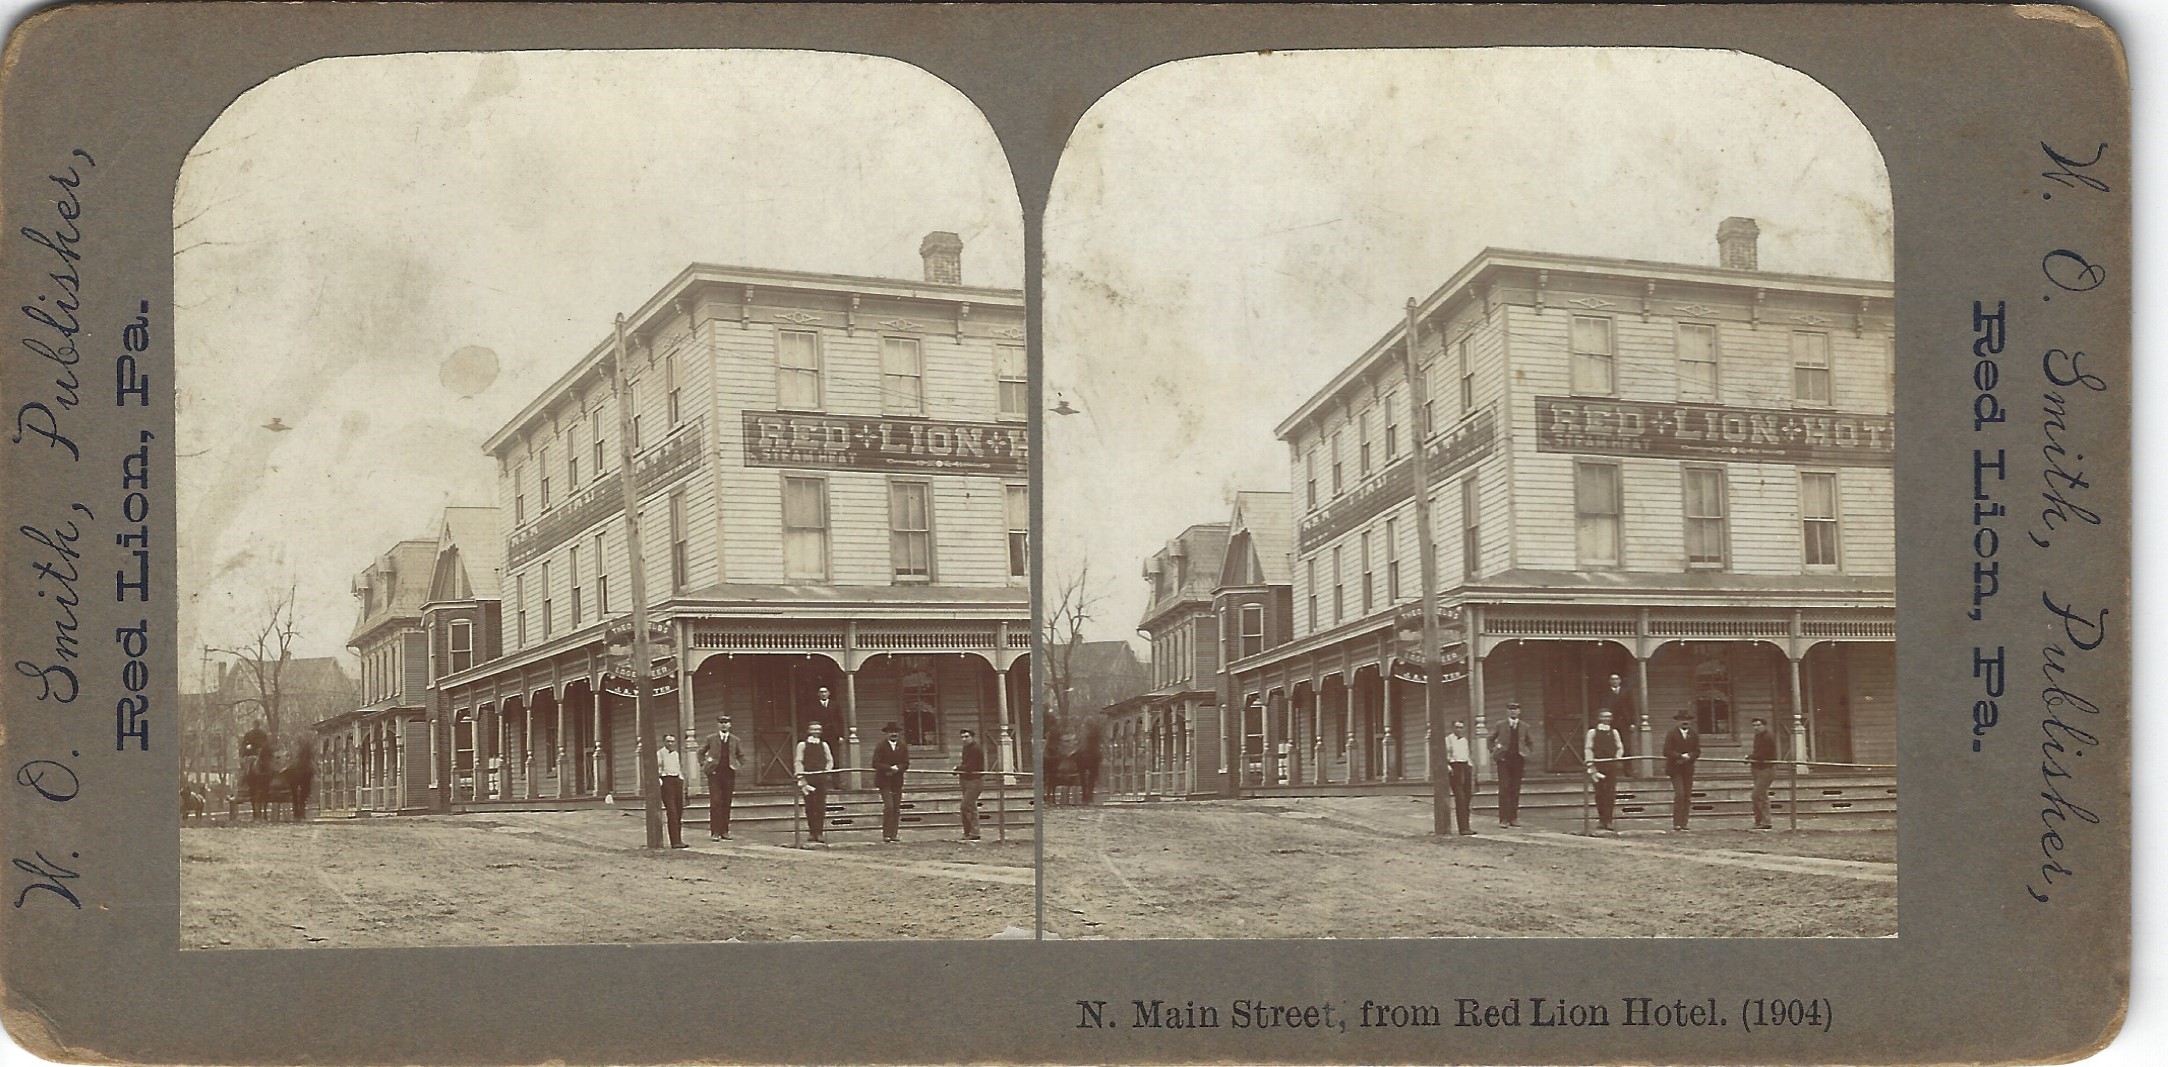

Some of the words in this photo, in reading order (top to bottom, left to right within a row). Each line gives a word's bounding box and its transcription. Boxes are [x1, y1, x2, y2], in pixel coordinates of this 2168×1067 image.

[757, 416, 851, 451] RED
[878, 423, 985, 458] LION
[1549, 402, 1645, 437] RED
[1674, 408, 1780, 445] LION
[1803, 416, 1895, 449] HOT
